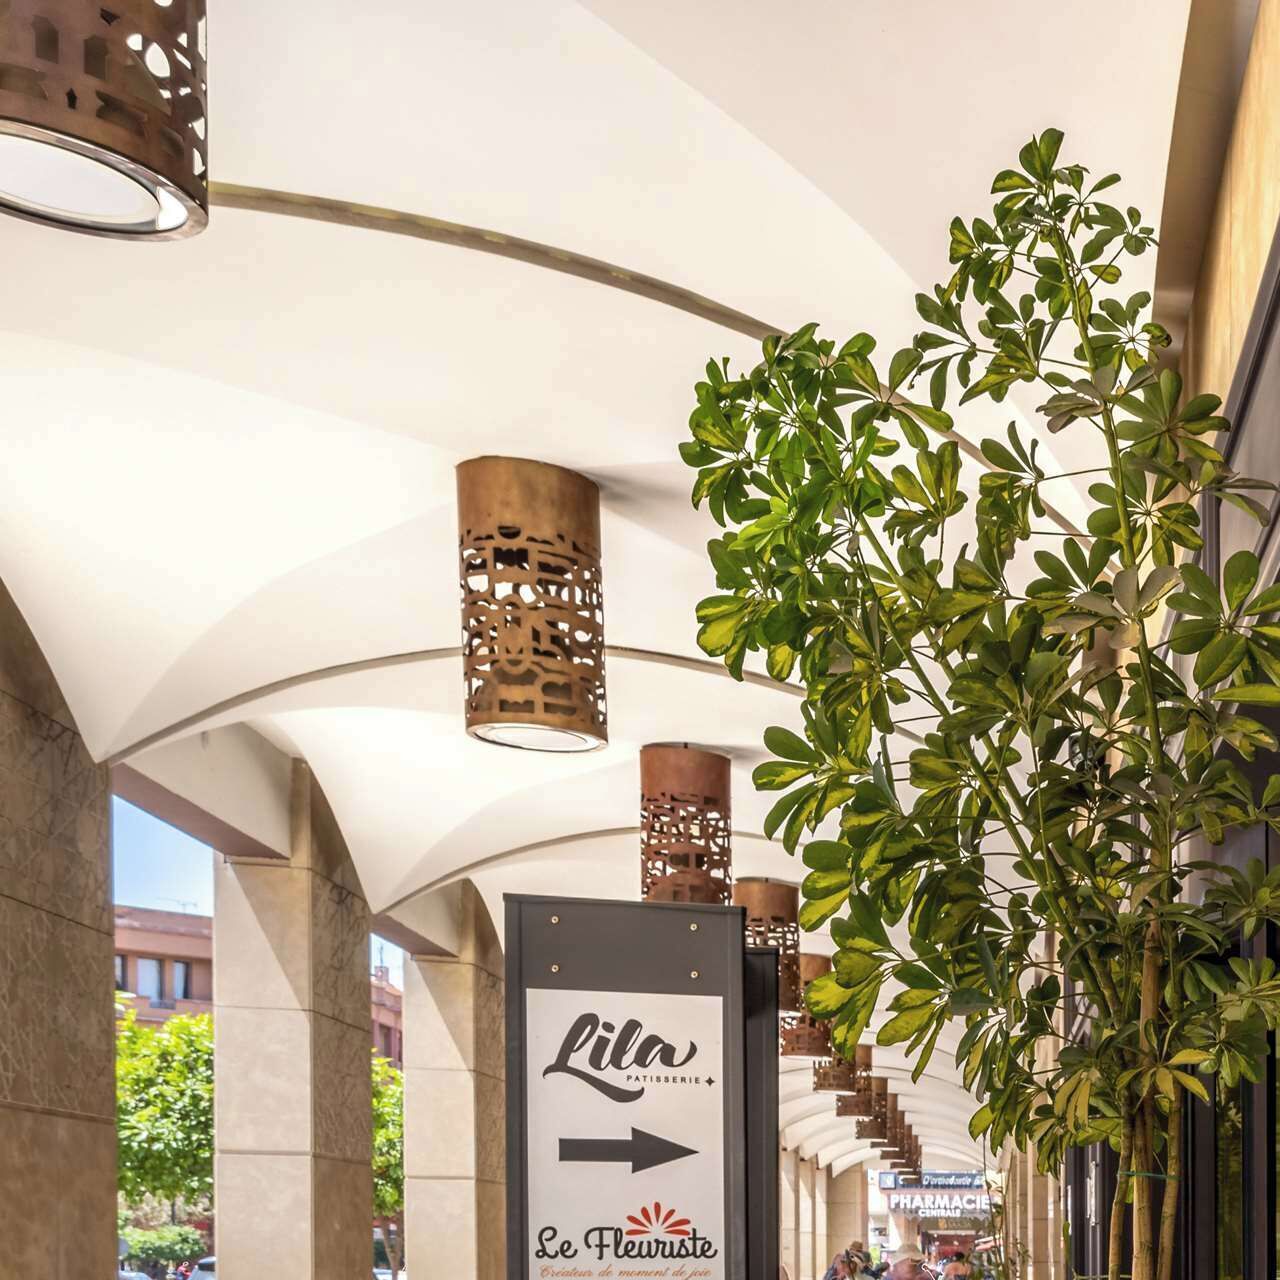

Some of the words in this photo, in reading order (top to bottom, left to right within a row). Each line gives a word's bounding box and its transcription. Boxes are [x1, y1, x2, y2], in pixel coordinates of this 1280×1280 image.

[543, 1013, 697, 1103] Lila
[626, 1074, 701, 1085] PATISSERIE
[890, 1194, 990, 1209] PHARMACIE
[919, 1209, 961, 1218] CENTRALE
[535, 1226, 578, 1259] Le
[584, 1226, 718, 1261] Fleuriste
[598, 1264, 613, 1278] de
[618, 1267, 671, 1278] moment
[672, 1264, 688, 1278] de
